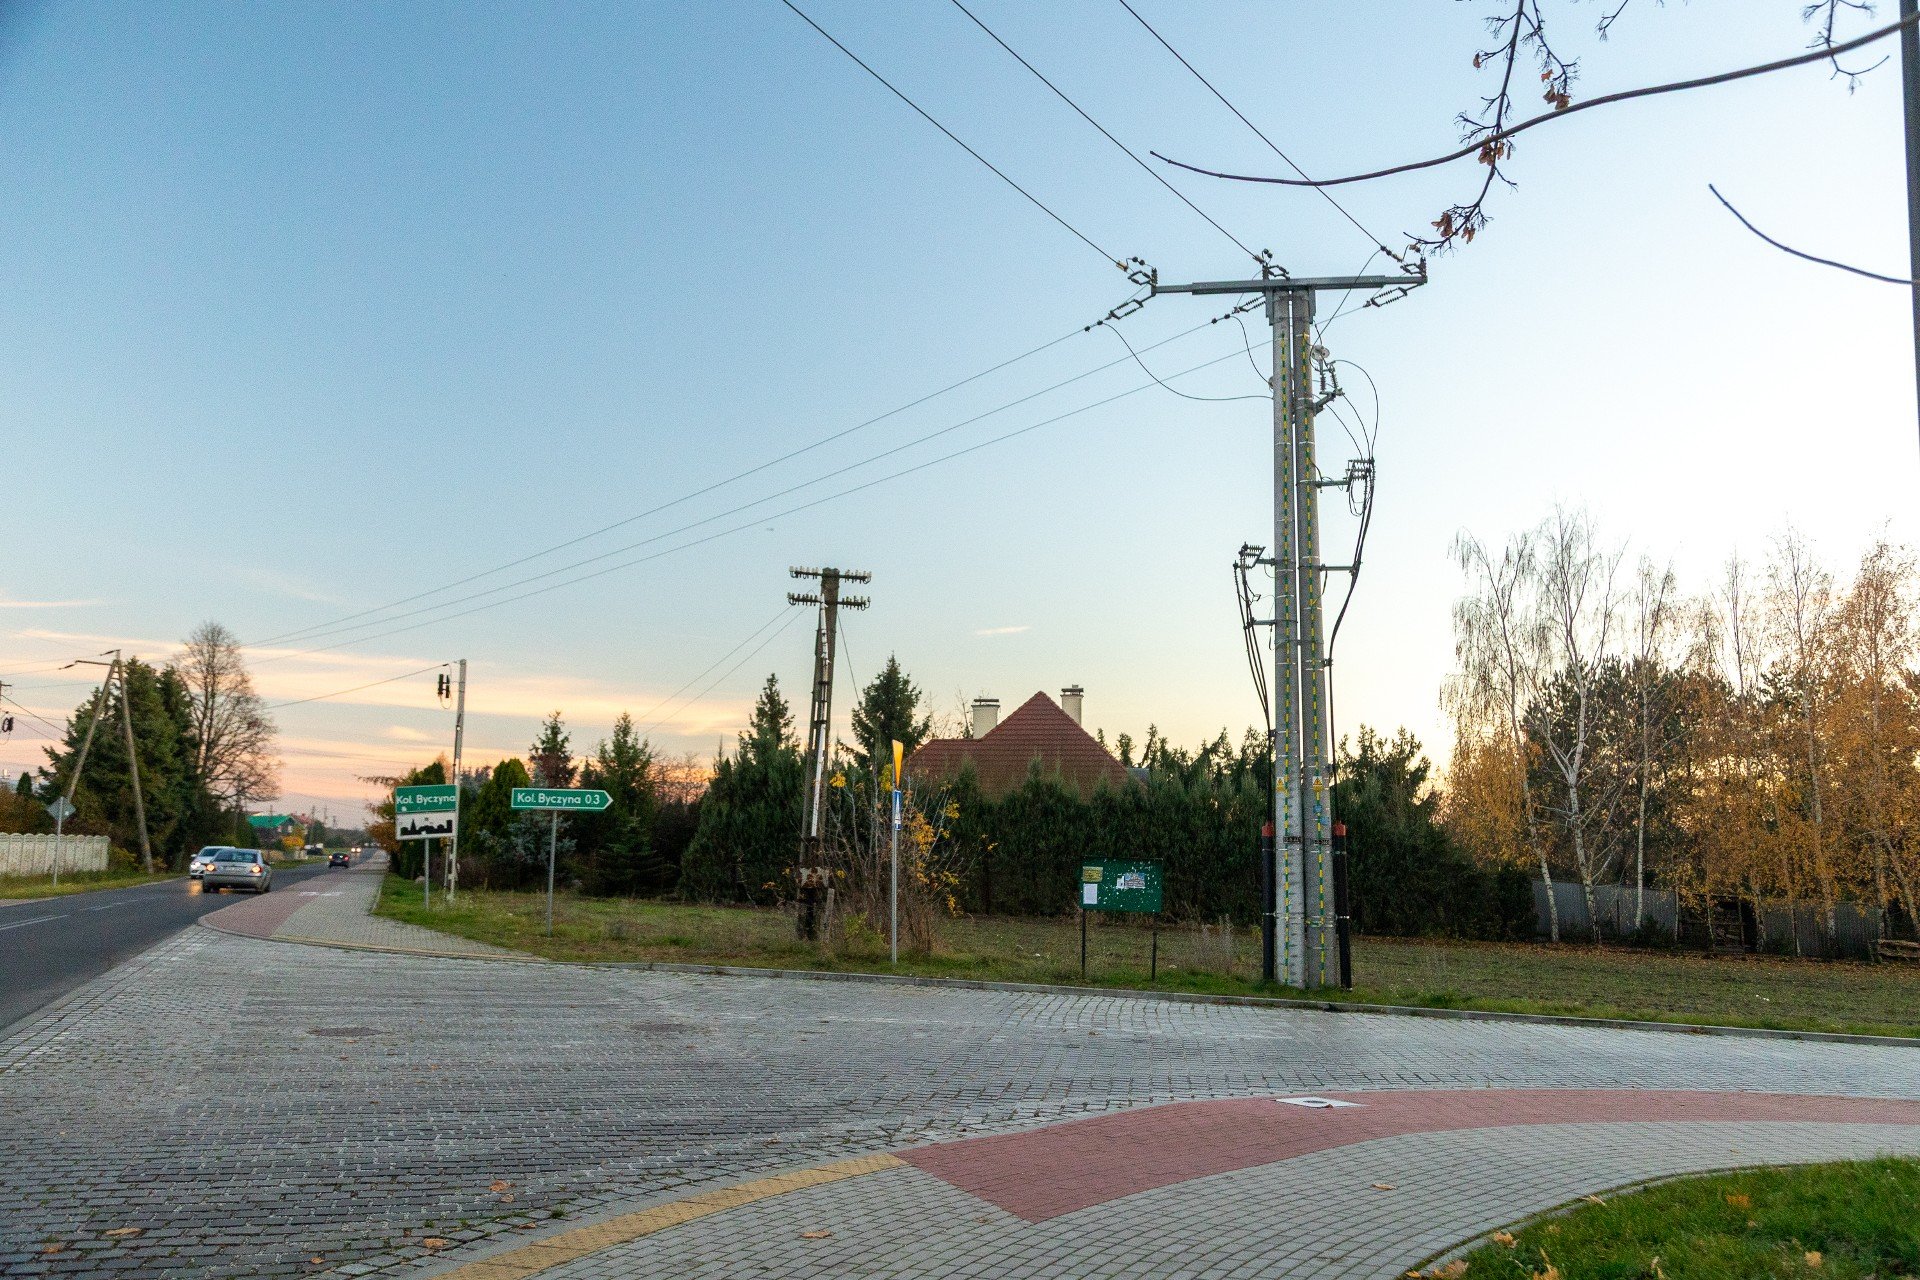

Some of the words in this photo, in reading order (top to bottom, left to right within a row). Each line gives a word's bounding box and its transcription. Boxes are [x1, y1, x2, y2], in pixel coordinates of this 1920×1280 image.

[416, 794, 456, 805] Byczyna
[517, 793, 536, 802] Kol.
[538, 793, 581, 806] Byczyna
